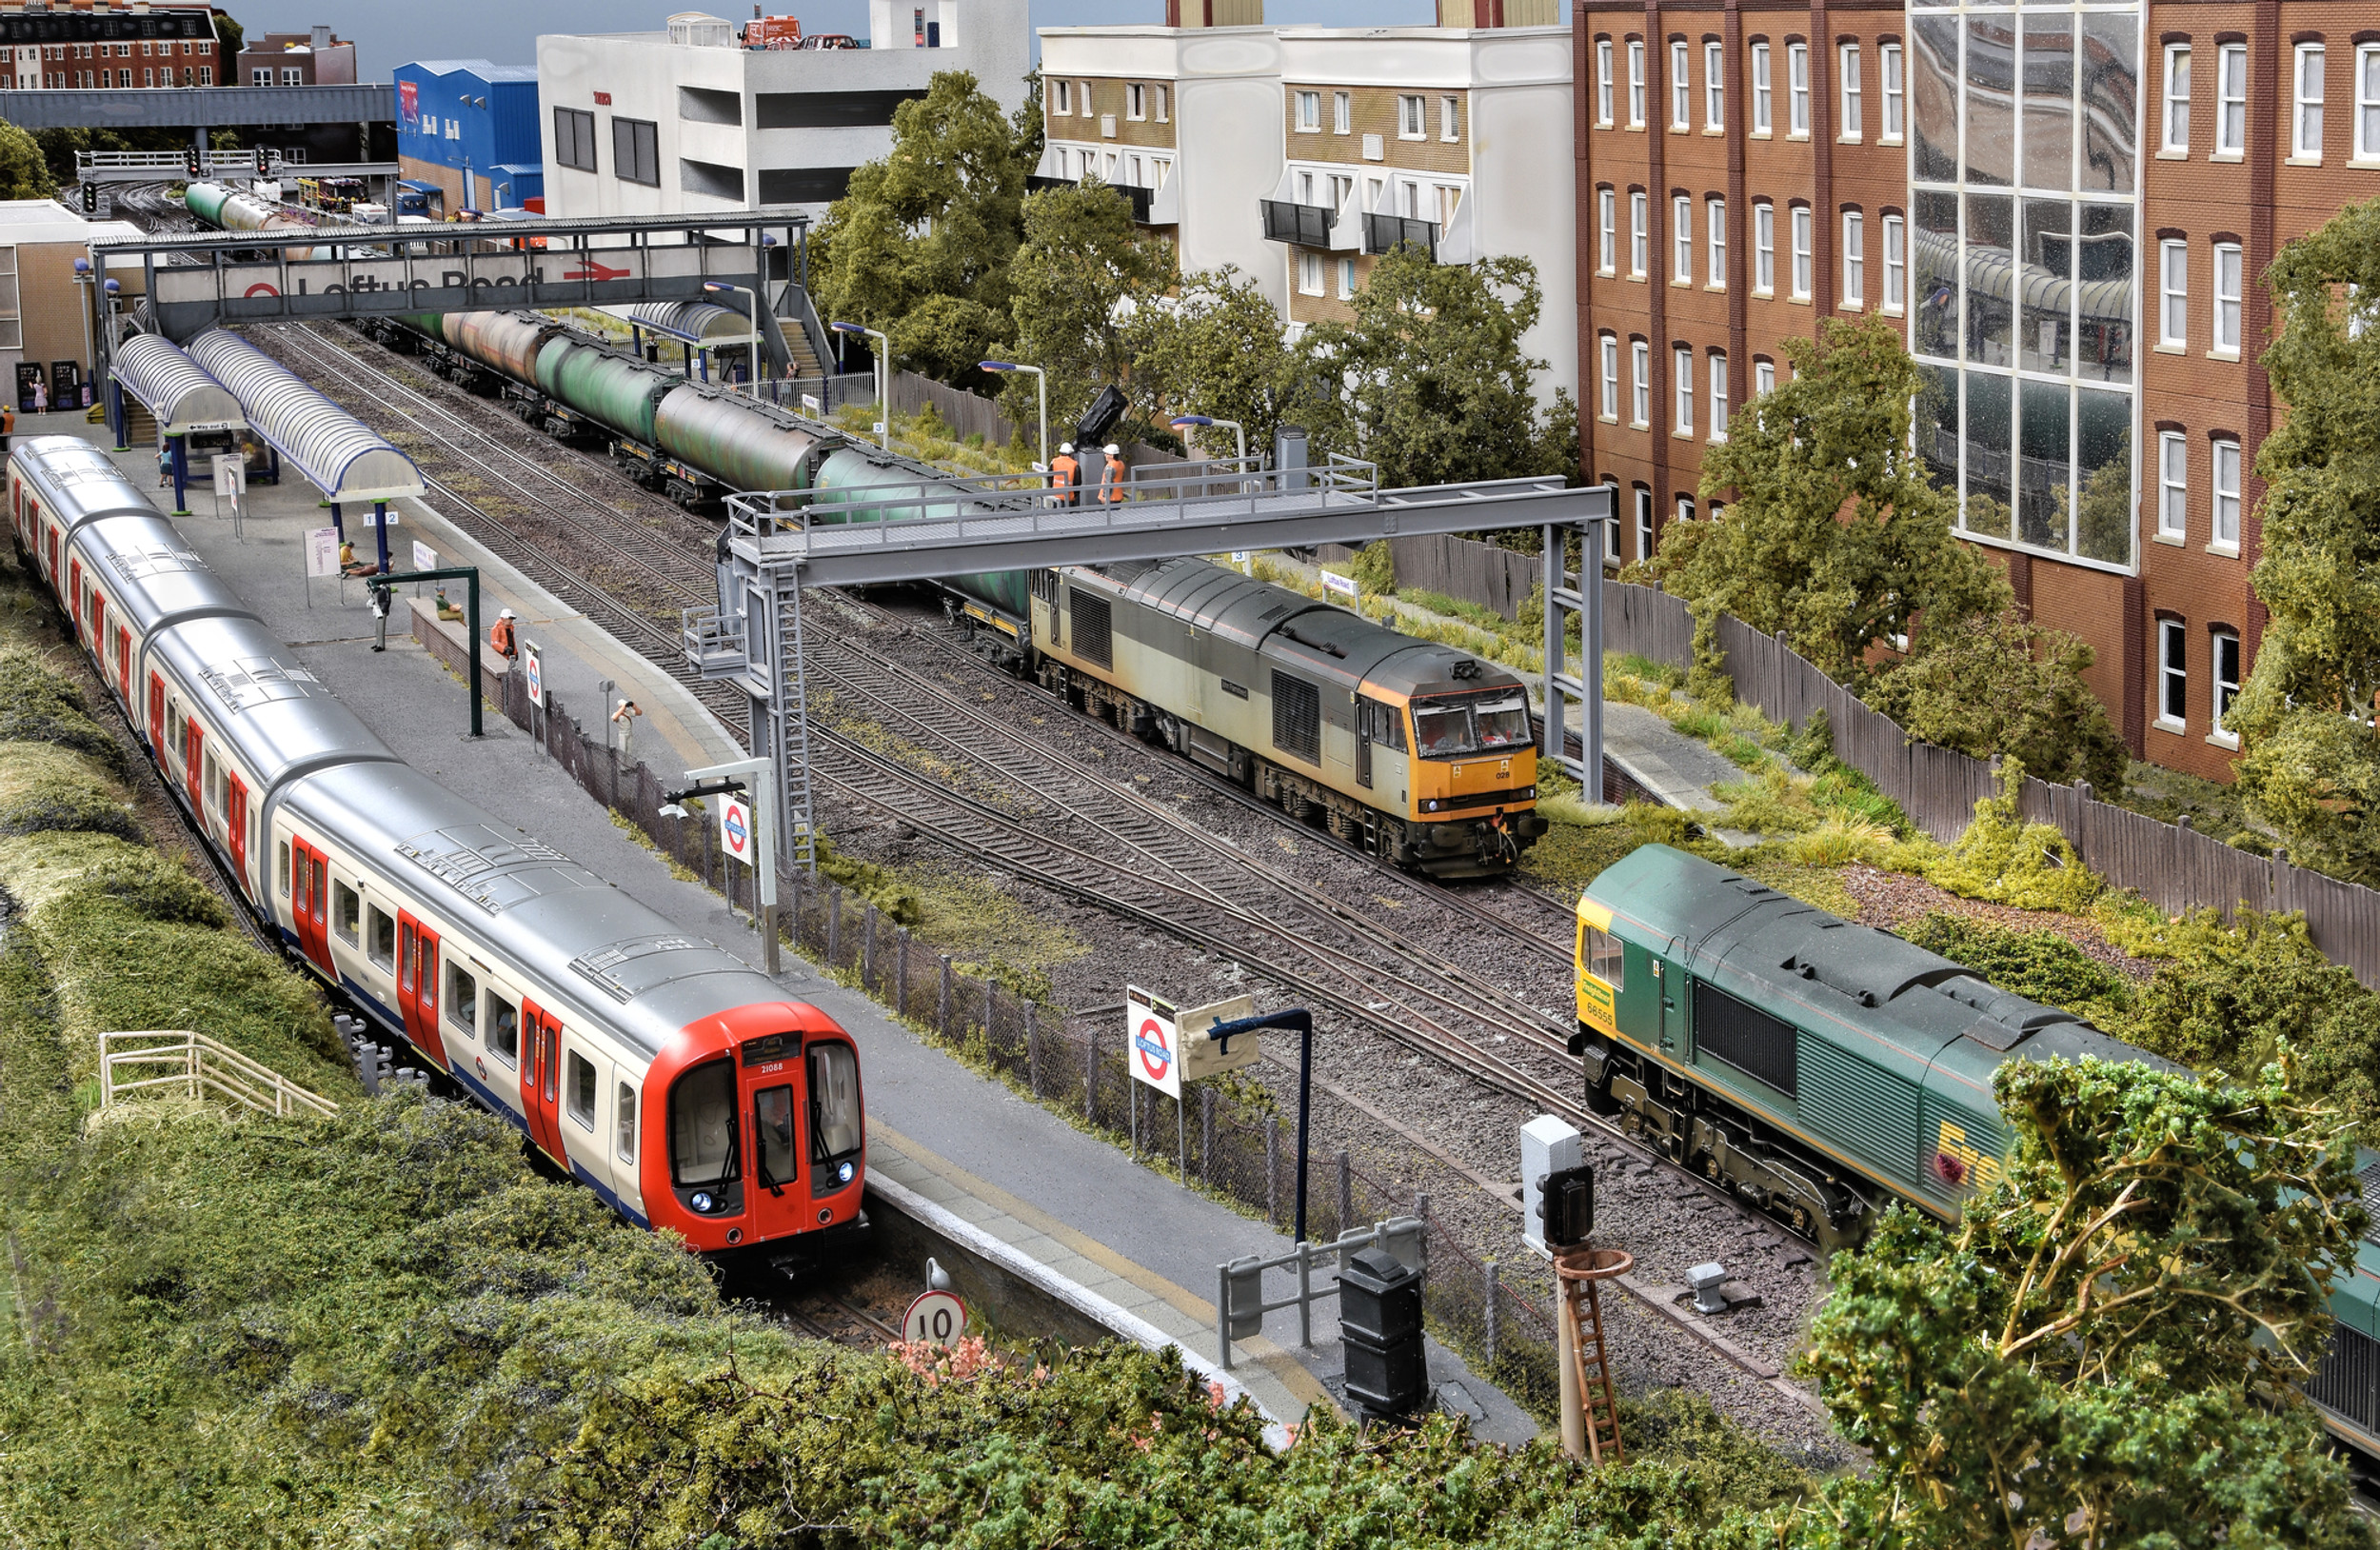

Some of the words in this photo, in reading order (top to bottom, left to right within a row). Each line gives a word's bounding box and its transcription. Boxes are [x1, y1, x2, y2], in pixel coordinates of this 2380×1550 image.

[388, 513, 395, 523] 2
[1496, 771, 1510, 780] 028
[1587, 1002, 1613, 1026] 66555
[1137, 1038, 1156, 1055] LOFTUS
[1155, 1046, 1170, 1062] ROAD
[762, 1063, 783, 1074] 21088
[919, 1307, 952, 1341] 10
